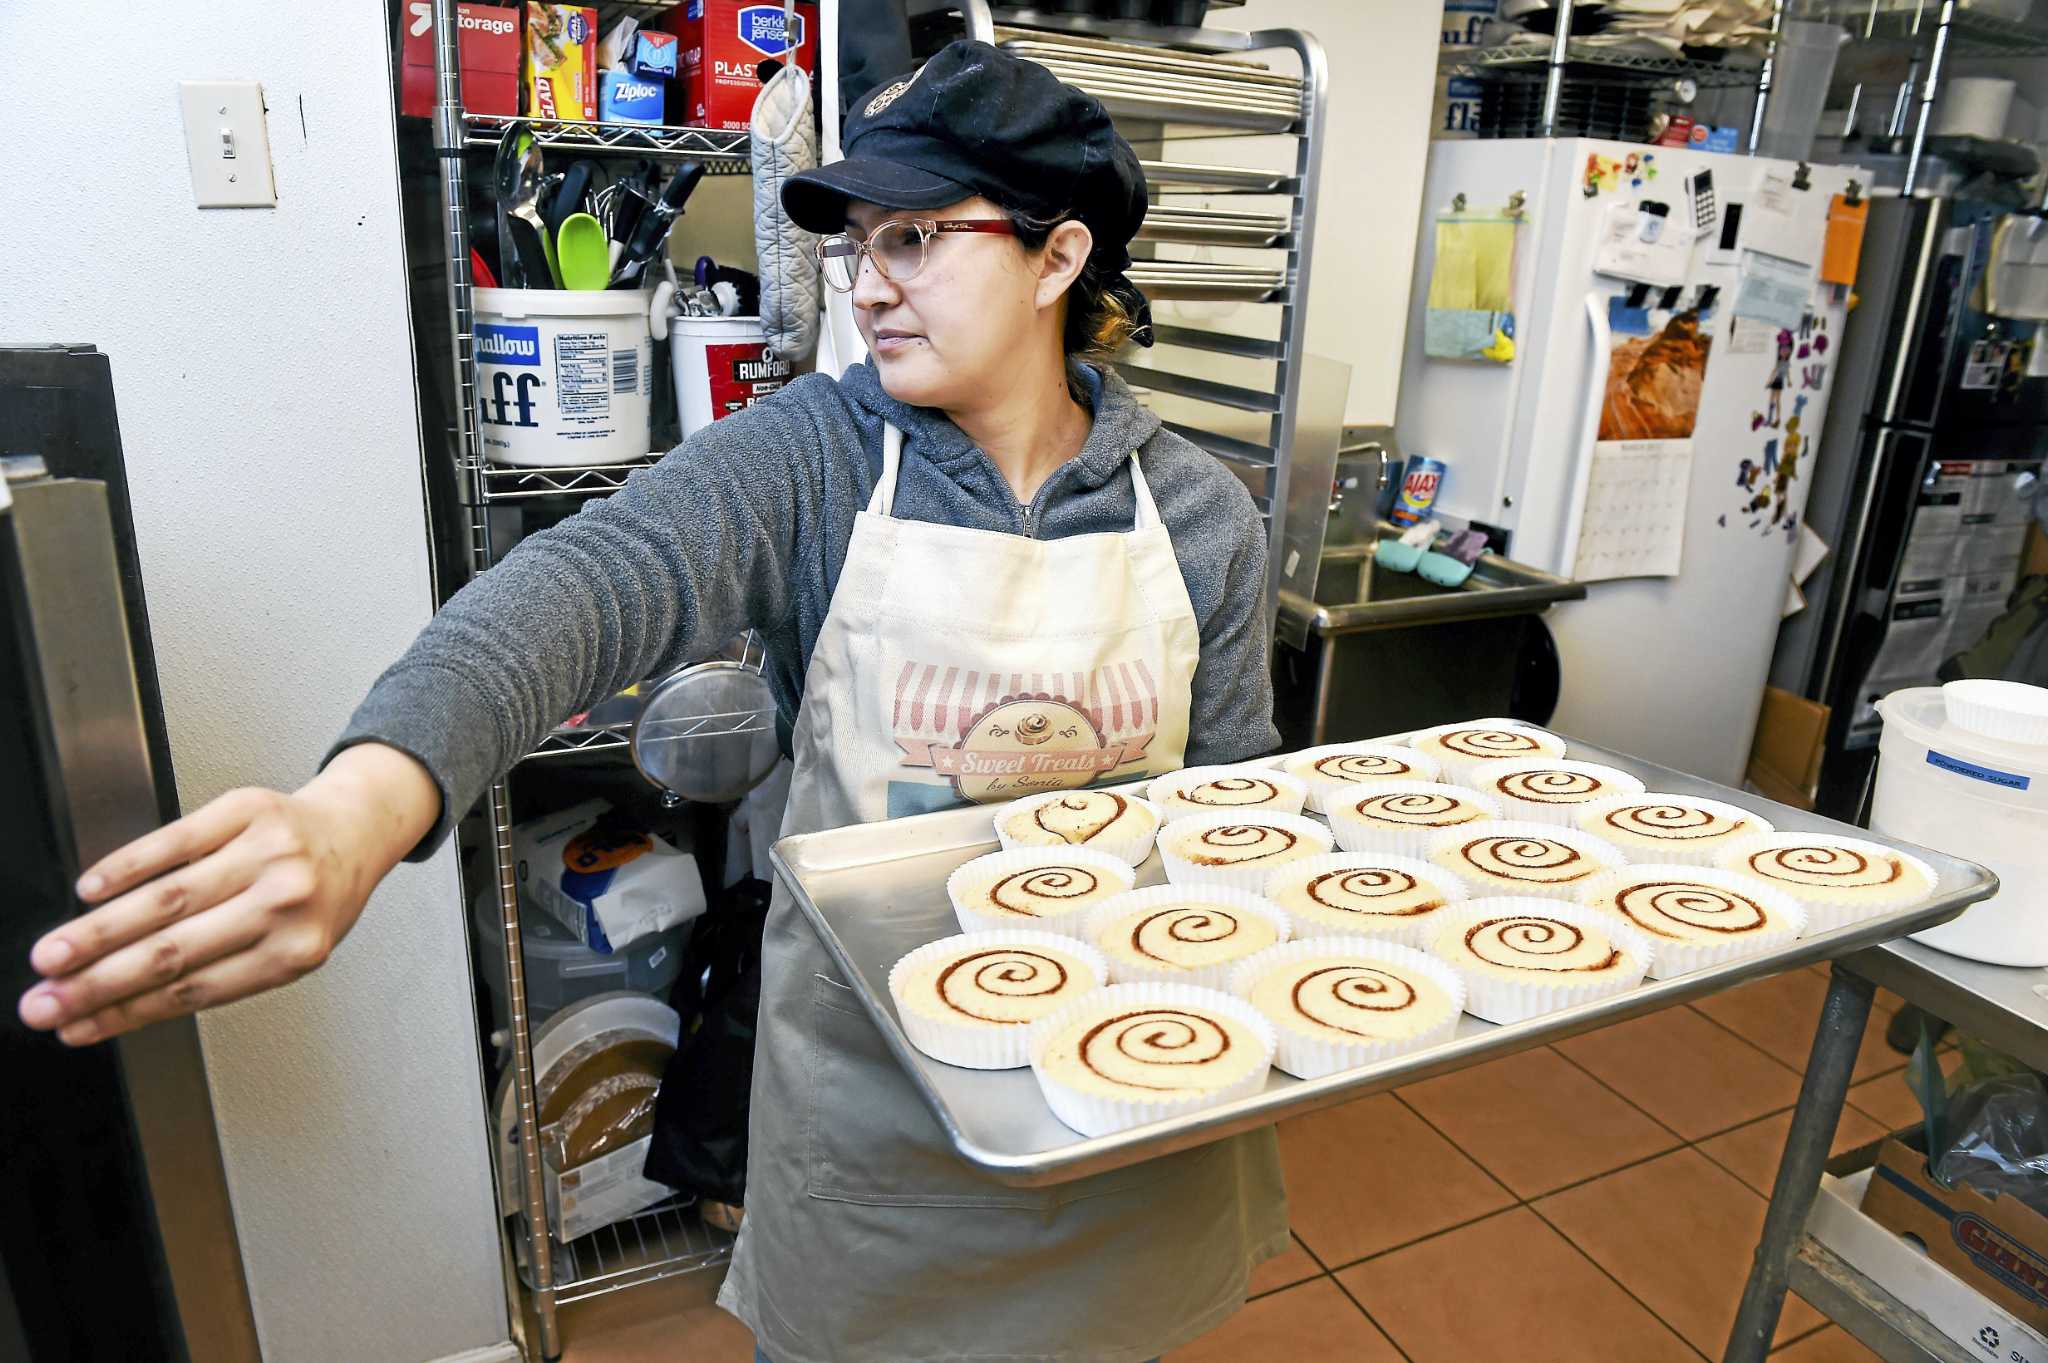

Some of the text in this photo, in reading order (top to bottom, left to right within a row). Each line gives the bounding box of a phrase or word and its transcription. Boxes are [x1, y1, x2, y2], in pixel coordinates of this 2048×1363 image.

[457, 14, 514, 35] torage
[751, 12, 785, 28] berkle
[750, 27, 788, 41] jense
[536, 78, 557, 119] GLAD
[615, 81, 657, 102] Ziploc
[960, 751, 1096, 774] Sweet Treats
[1987, 774, 2022, 787] SUGAR
